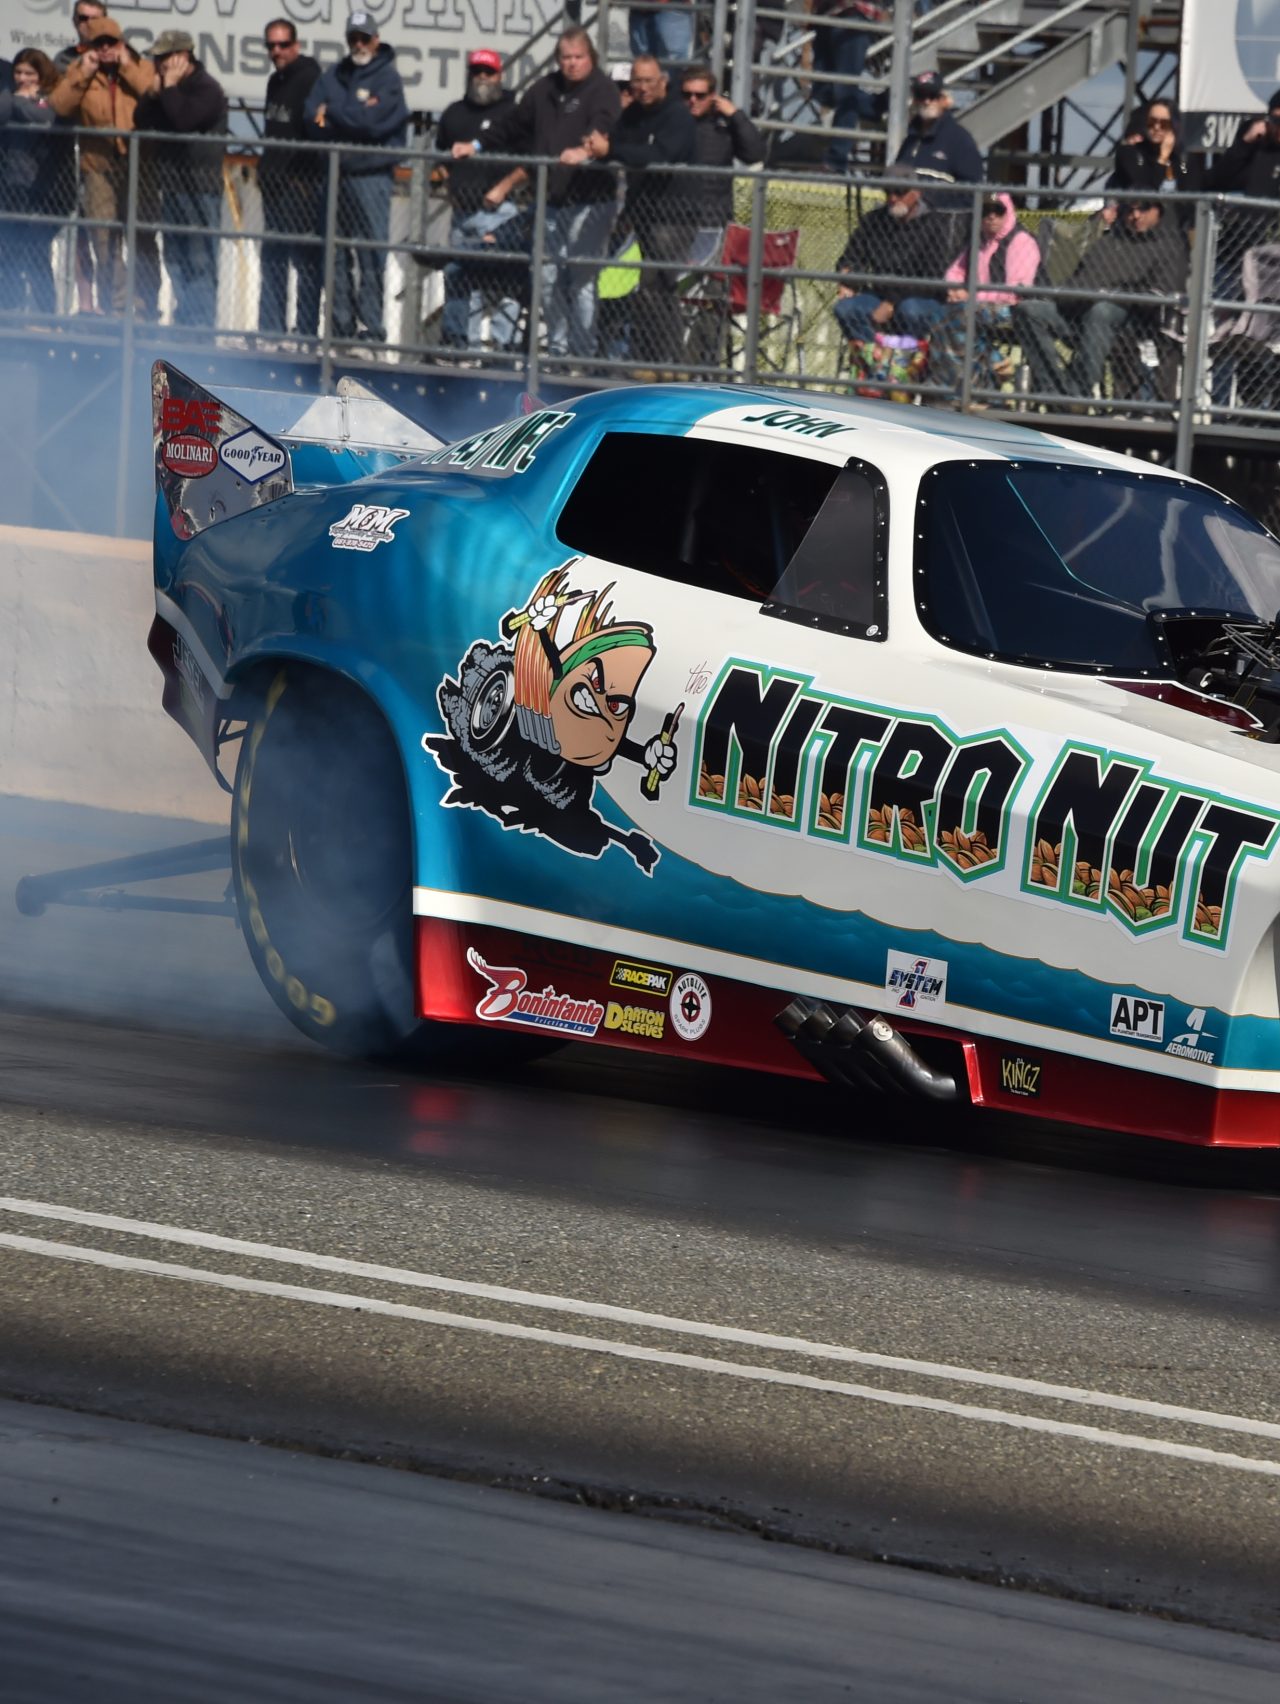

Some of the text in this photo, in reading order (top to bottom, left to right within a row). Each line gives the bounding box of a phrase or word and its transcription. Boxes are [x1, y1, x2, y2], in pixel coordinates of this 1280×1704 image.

[162, 399, 222, 434] BAE
[741, 410, 859, 438] JOHN
[166, 442, 213, 463] MOLINARI
[695, 662, 1029, 877] NITRO
[623, 968, 667, 989] RACEPAK
[677, 976, 707, 1000] AUTOLITE
[888, 969, 943, 996] SYSTEM
[620, 1018, 664, 1038] SLEEVES
[1112, 996, 1163, 1035] APT
[1165, 1042, 1215, 1064] AEROMOTIVE
